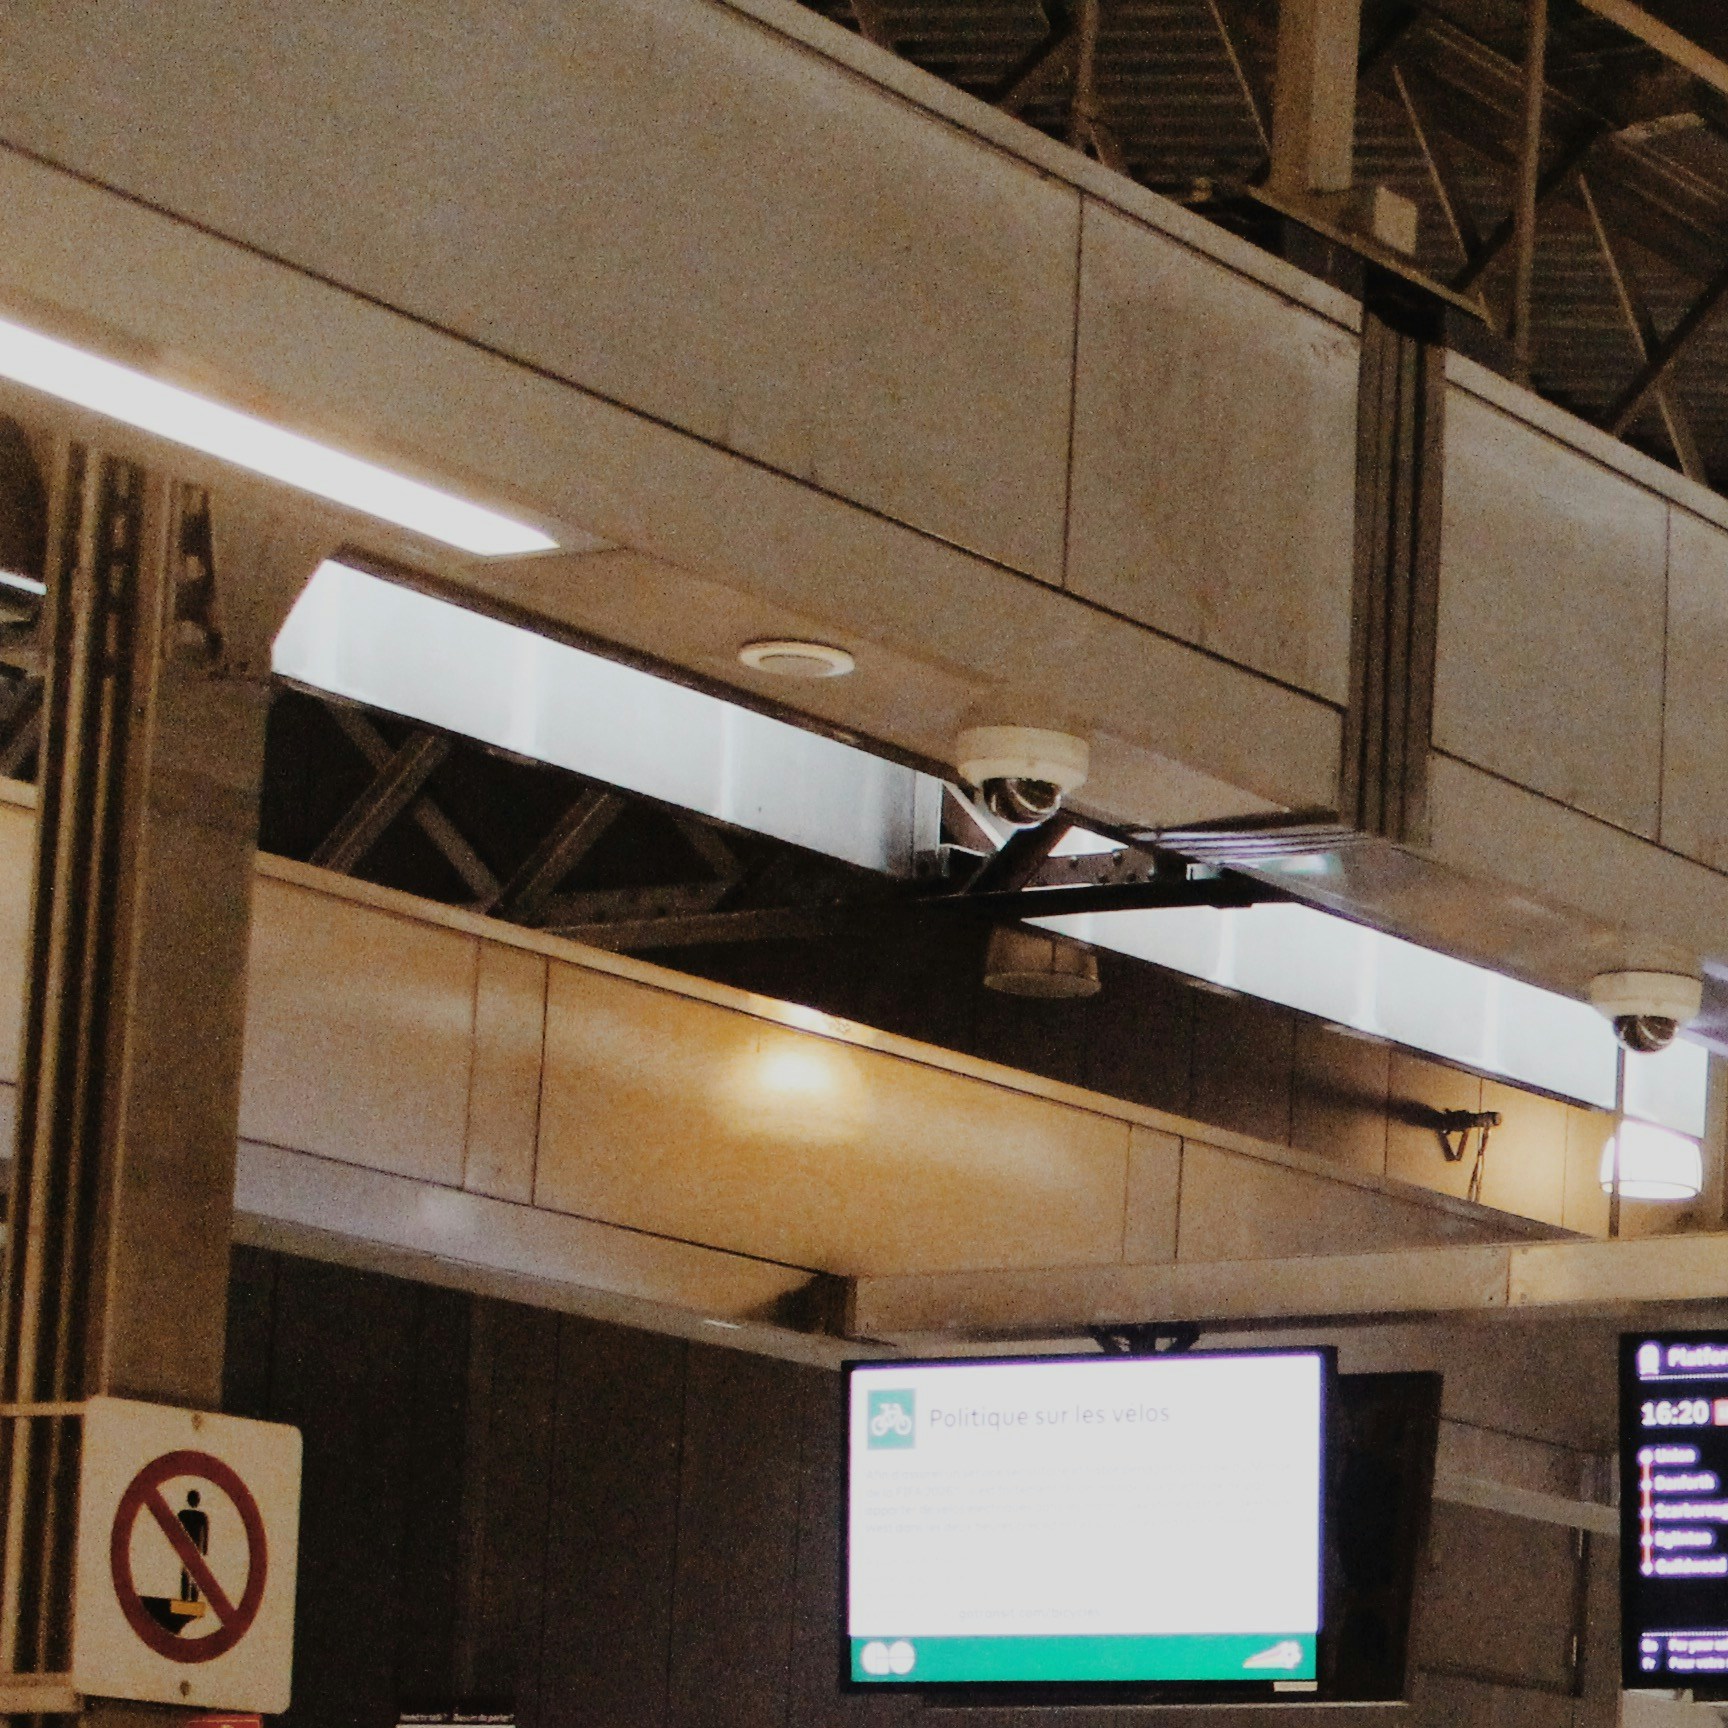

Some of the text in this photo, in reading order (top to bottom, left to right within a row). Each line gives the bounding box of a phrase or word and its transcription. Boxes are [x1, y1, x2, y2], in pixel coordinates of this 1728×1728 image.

[930, 1407, 1028, 1433] Politique
[1036, 1408, 1068, 1425] sur
[1075, 1405, 1105, 1424] les
[1641, 1400, 1709, 1426] 16:20
